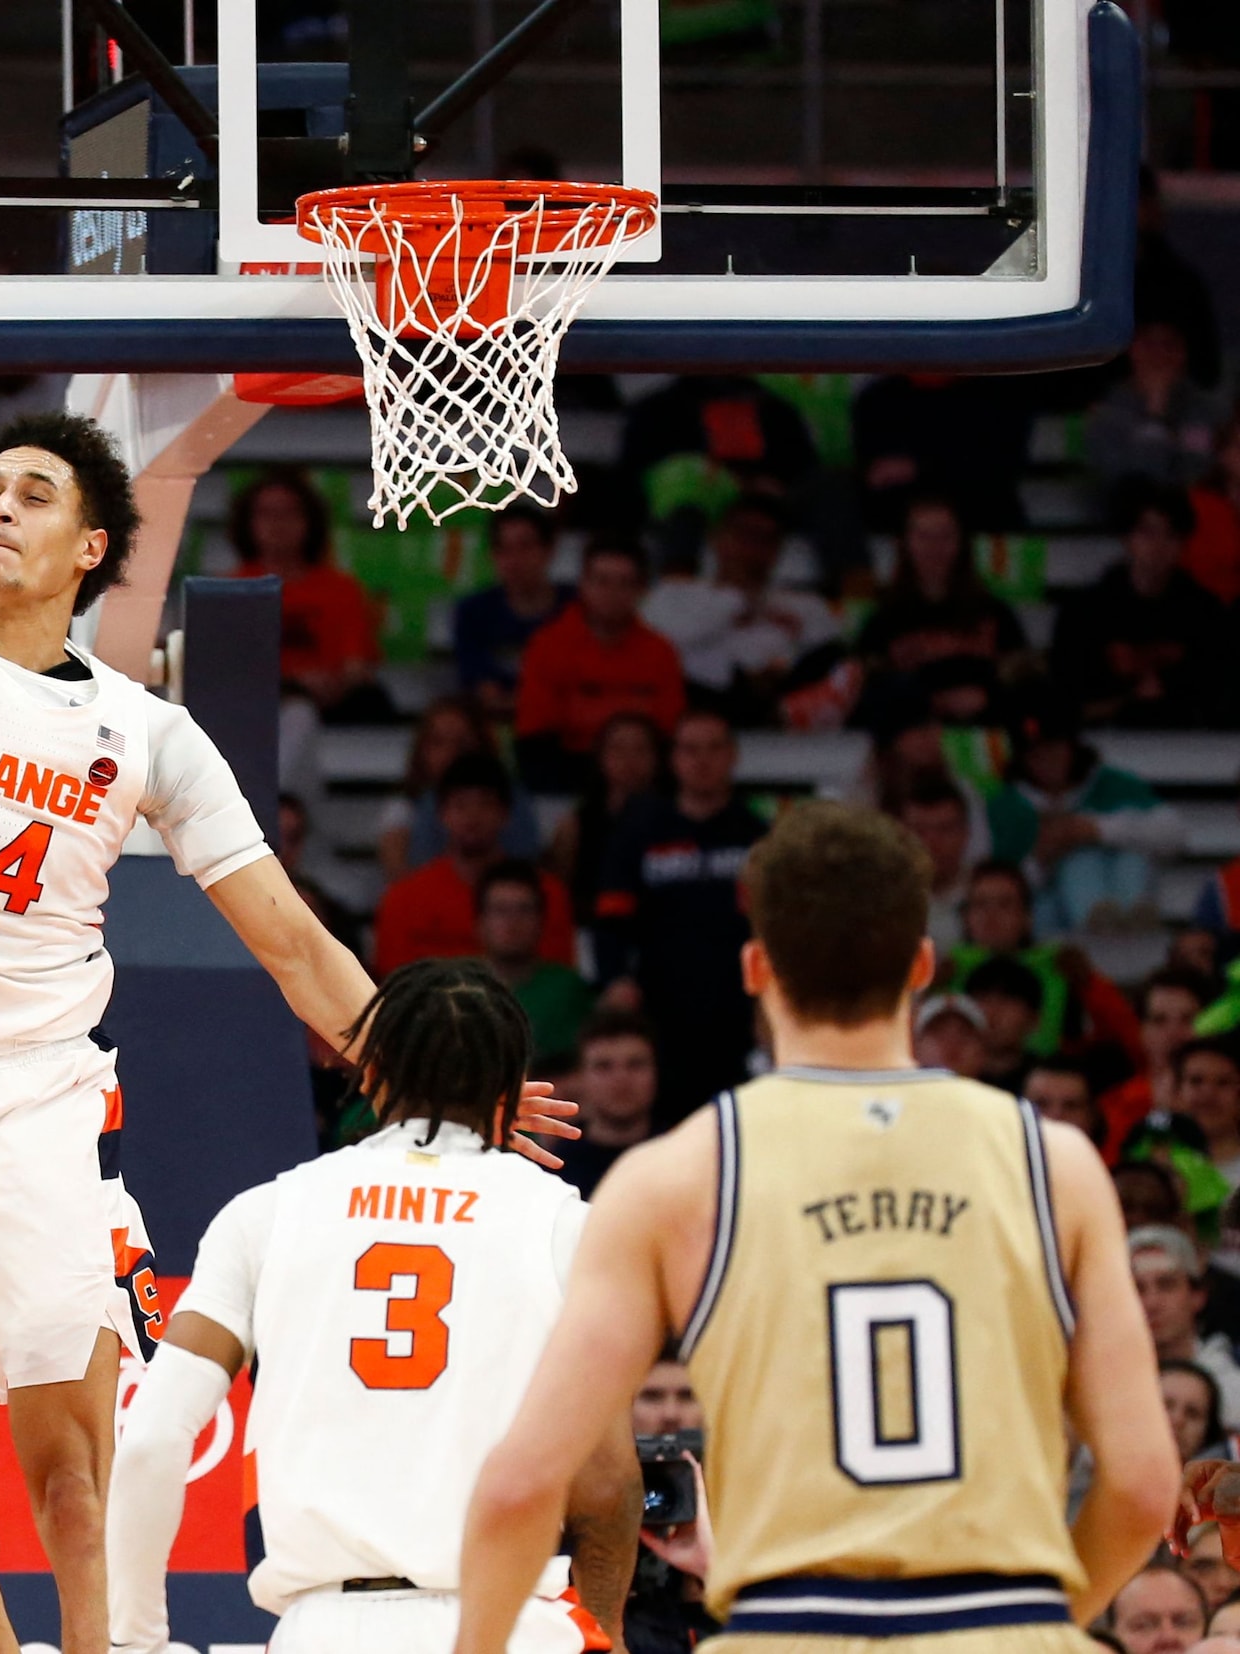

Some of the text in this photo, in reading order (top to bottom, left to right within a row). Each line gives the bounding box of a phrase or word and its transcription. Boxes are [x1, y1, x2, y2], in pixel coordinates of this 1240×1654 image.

[347, 1185, 480, 1224] MINTZ
[801, 1186, 971, 1244] TERRY
[349, 1242, 455, 1390] 3
[827, 1278, 964, 1488] 0
